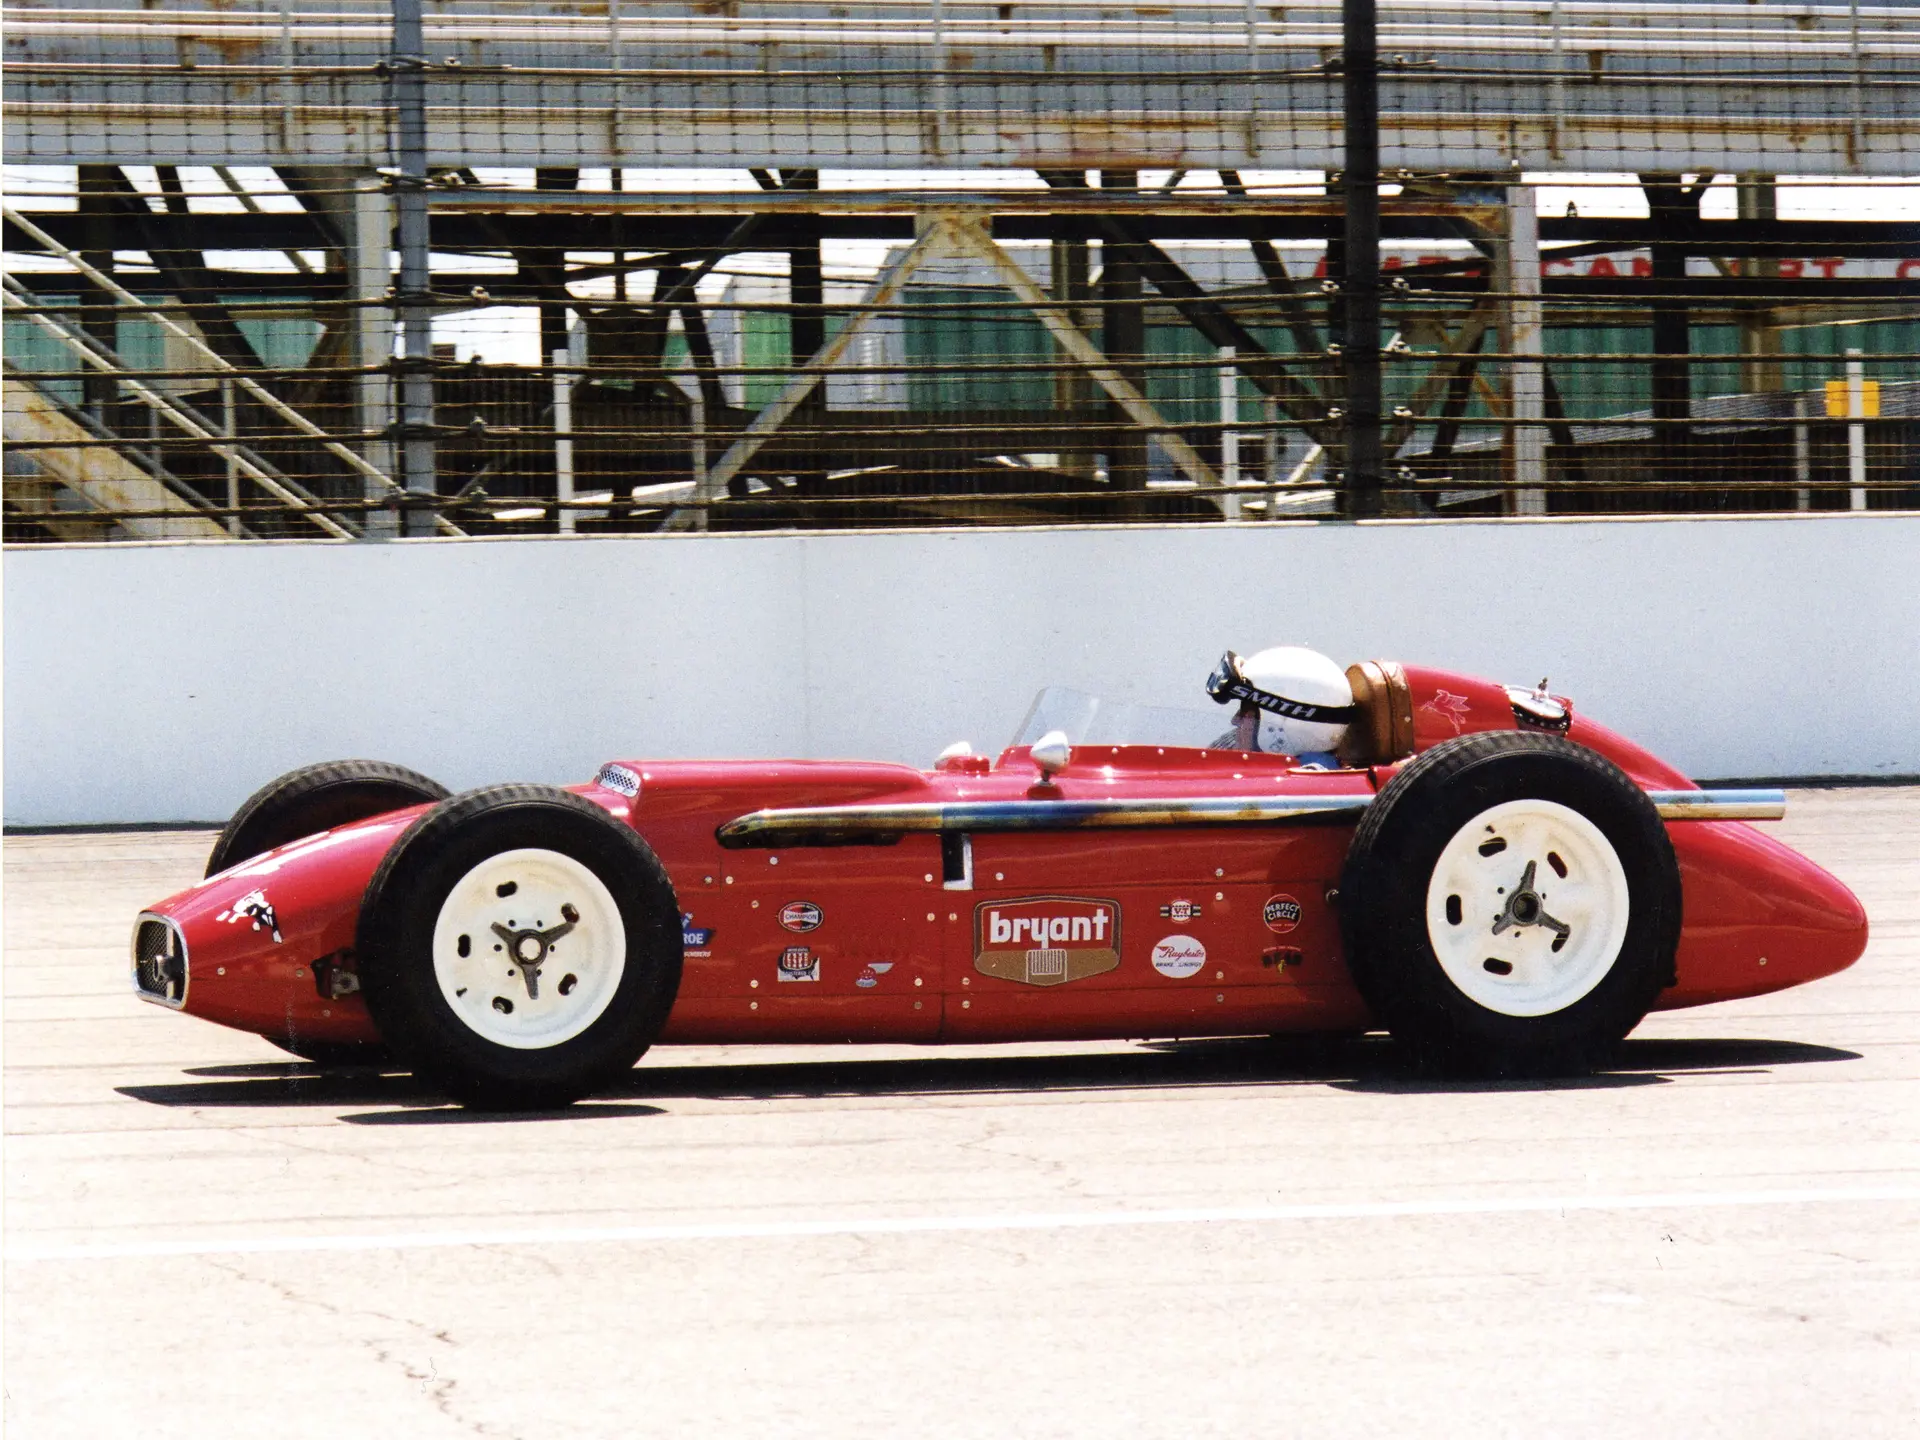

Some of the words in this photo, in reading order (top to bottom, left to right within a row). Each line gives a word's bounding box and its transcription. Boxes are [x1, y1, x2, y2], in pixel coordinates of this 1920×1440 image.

[1229, 685, 1317, 718] SMITH
[1266, 903, 1300, 914] PERFECT
[784, 913, 818, 921] CHAMPION
[1268, 910, 1297, 921] CIRCLE
[990, 909, 1109, 949] bryant
[1158, 946, 1205, 961] Raybestos
